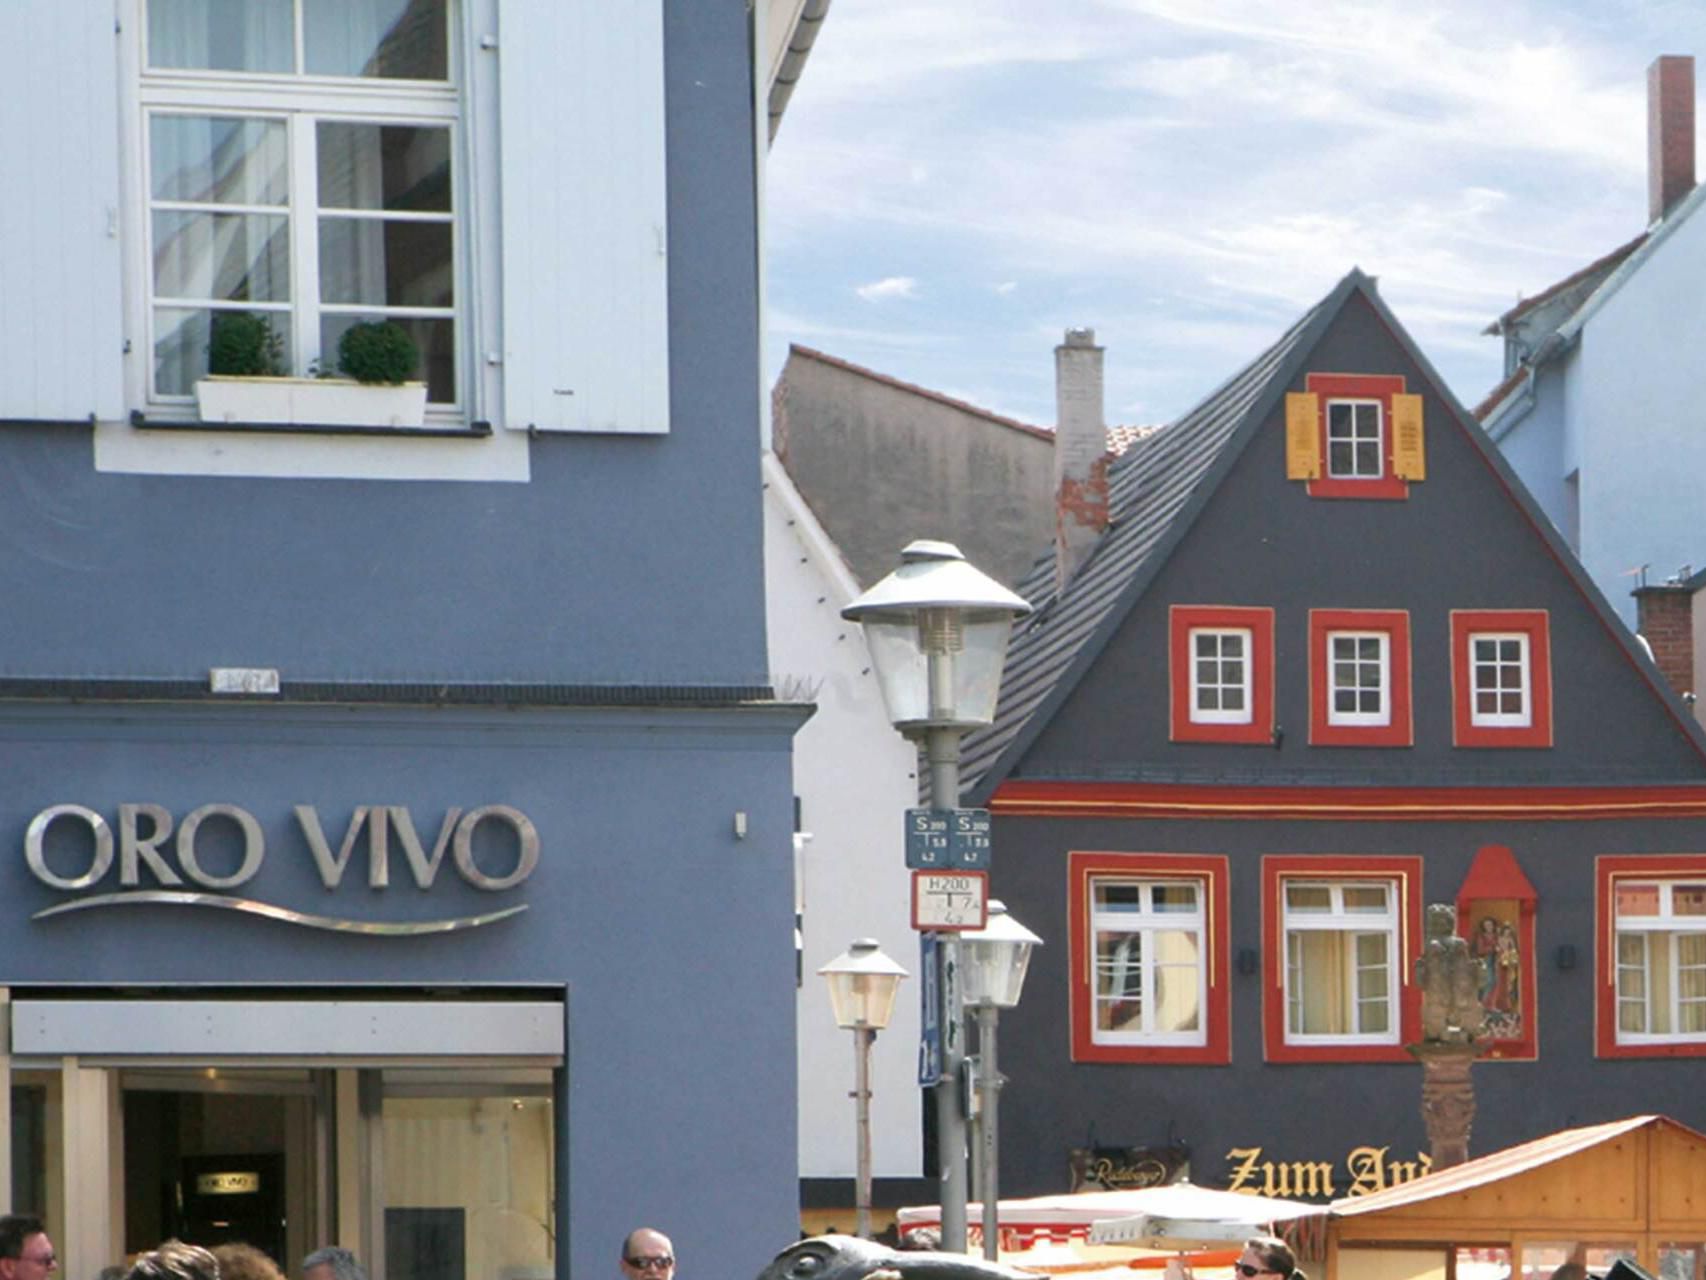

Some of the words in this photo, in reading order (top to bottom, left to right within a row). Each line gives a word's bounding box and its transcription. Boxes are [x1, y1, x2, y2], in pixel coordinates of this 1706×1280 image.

[24, 803, 265, 890] ORO
[294, 804, 540, 891] VIVO
[1225, 1147, 1336, 1198] Zum
